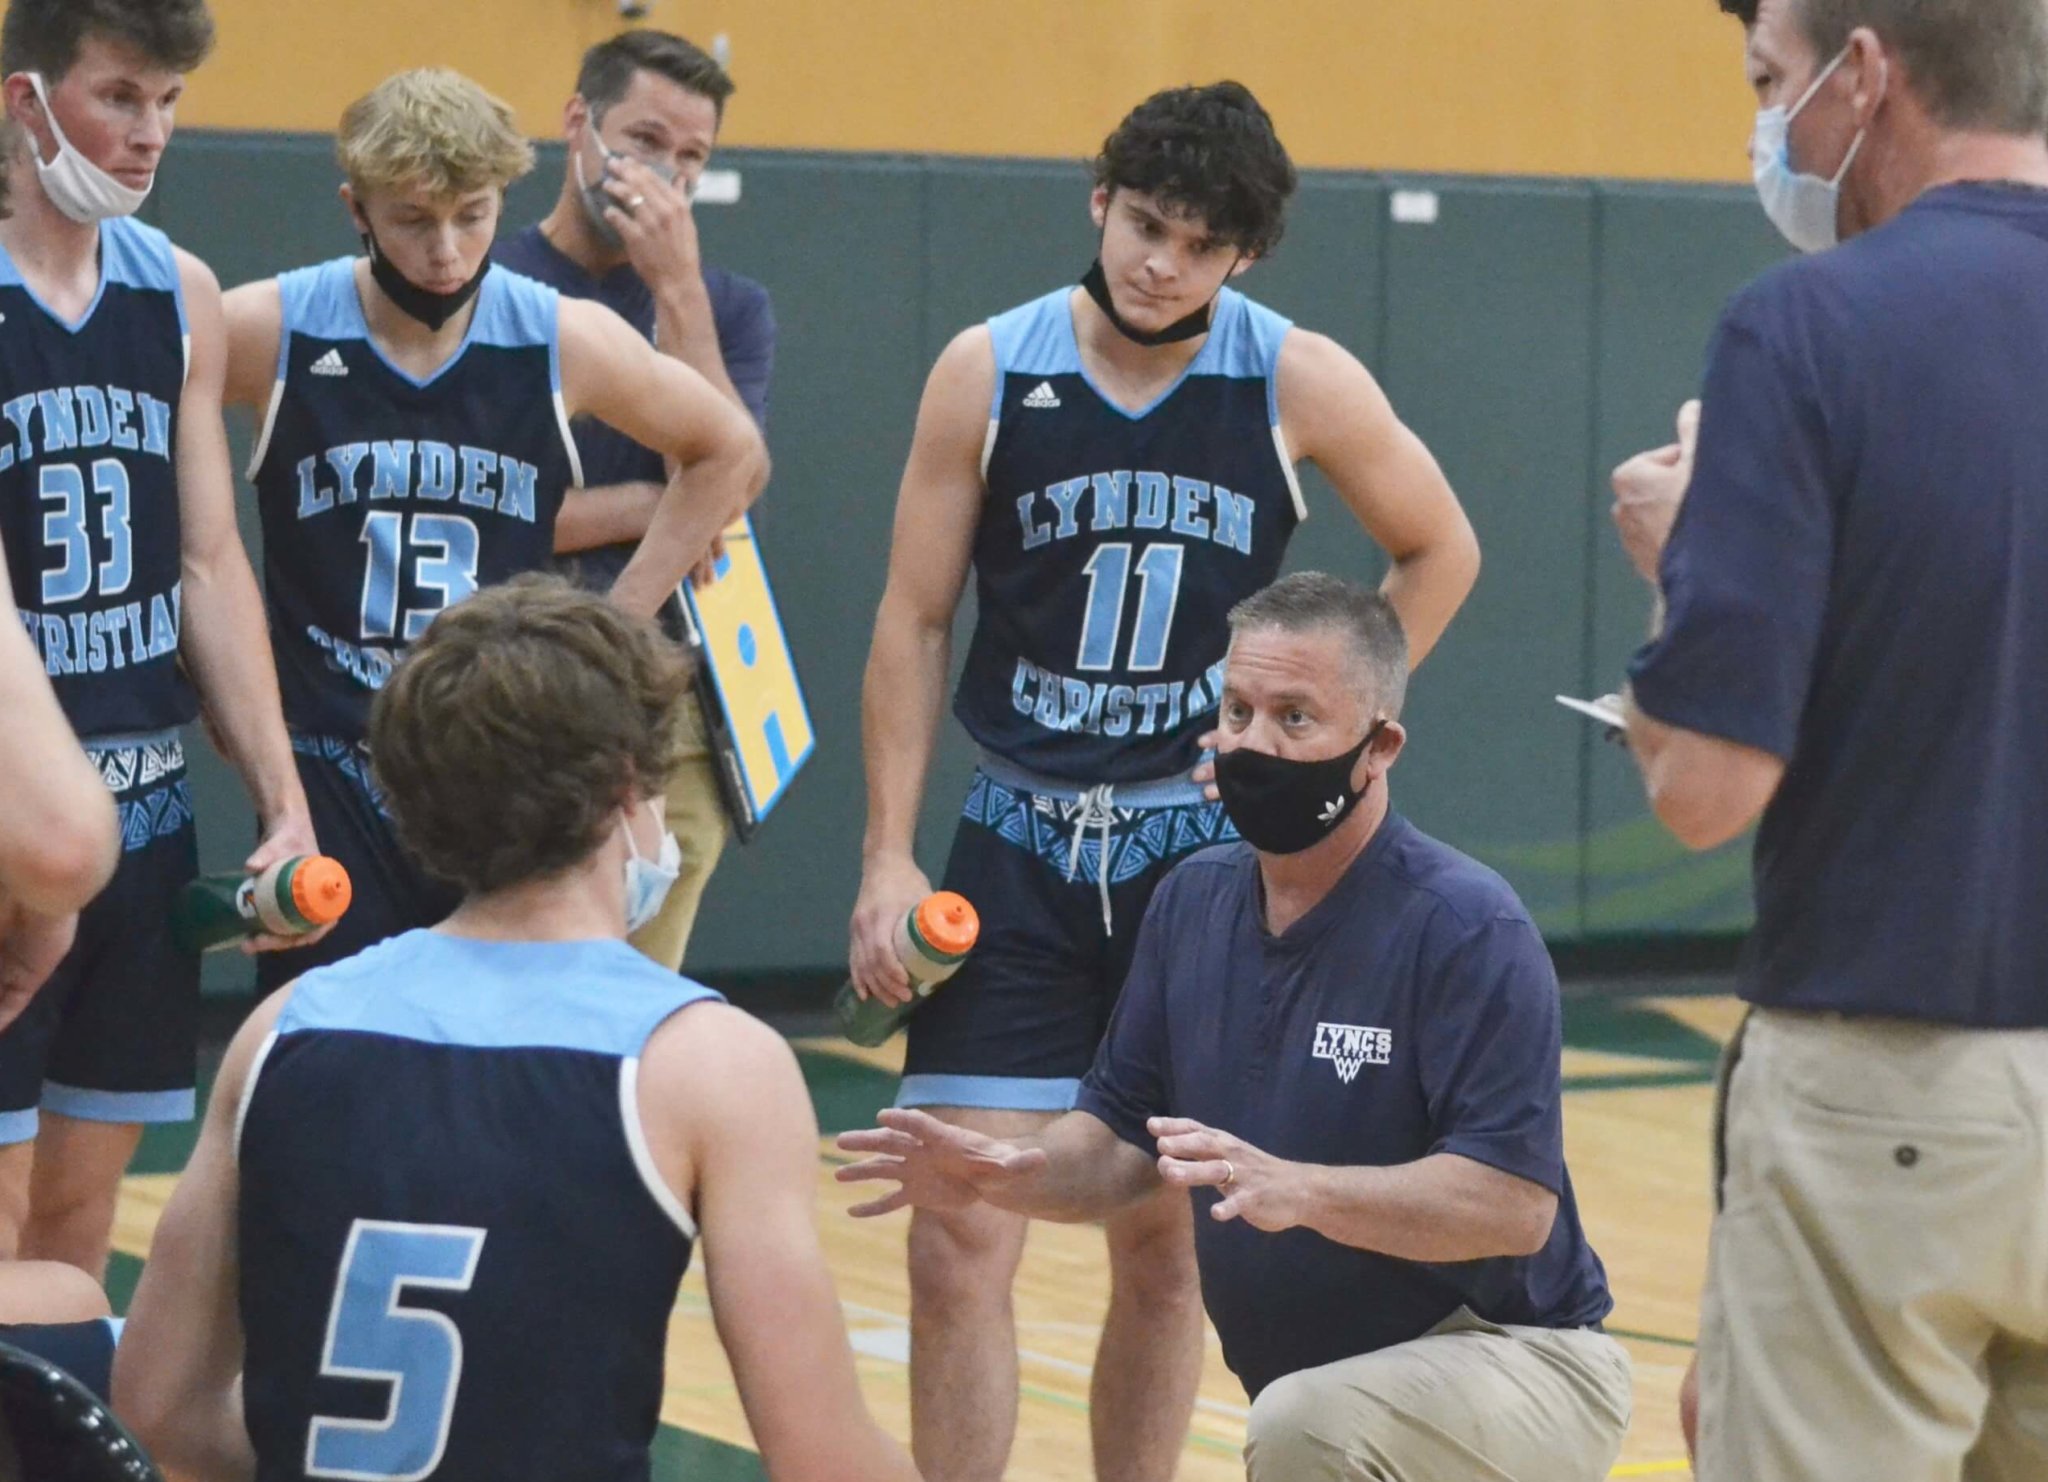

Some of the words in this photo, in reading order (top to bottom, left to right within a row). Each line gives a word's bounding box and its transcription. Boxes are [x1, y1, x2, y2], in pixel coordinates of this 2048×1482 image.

[1022, 398, 1061, 408] adidas
[39, 457, 132, 604] 33
[297, 439, 538, 523] LYNDEN
[1017, 470, 1255, 555] LYNDEN
[358, 510, 480, 641] 13
[1076, 542, 1184, 672] 11
[1314, 1026, 1392, 1055] LYNCS
[305, 1218, 487, 1482] 5
